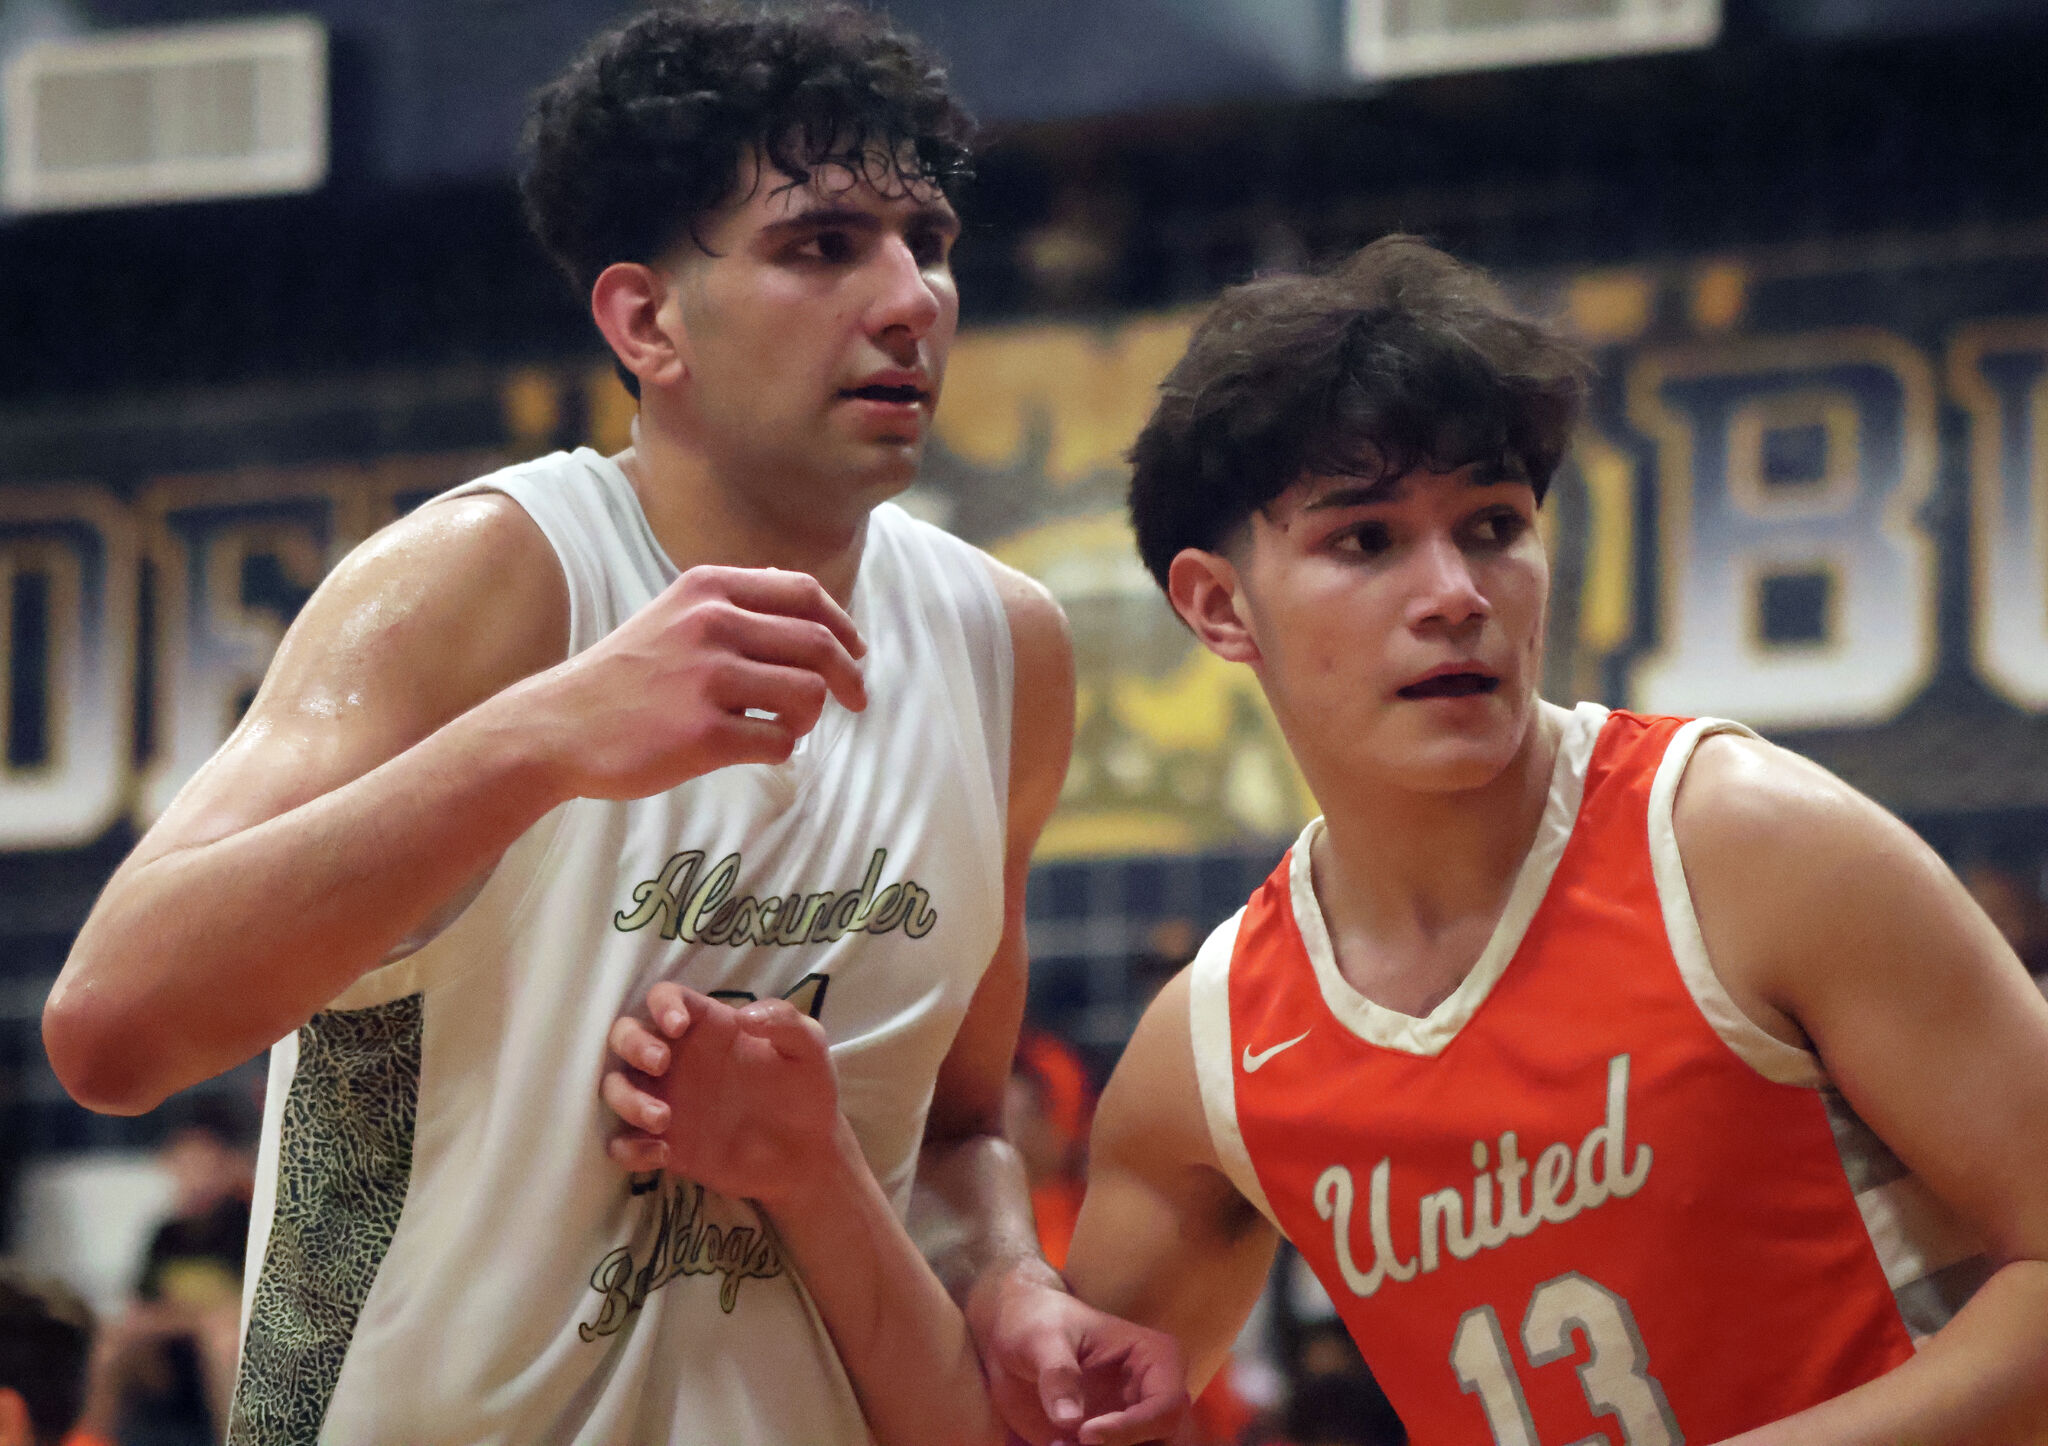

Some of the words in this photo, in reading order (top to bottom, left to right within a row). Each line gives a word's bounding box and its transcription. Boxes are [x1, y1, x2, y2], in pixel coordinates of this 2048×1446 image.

[614, 848, 937, 947] Alexander
[1313, 1053, 1653, 1297] United
[579, 1180, 784, 1343] Bldogs
[1449, 1269, 1685, 1446] 13
